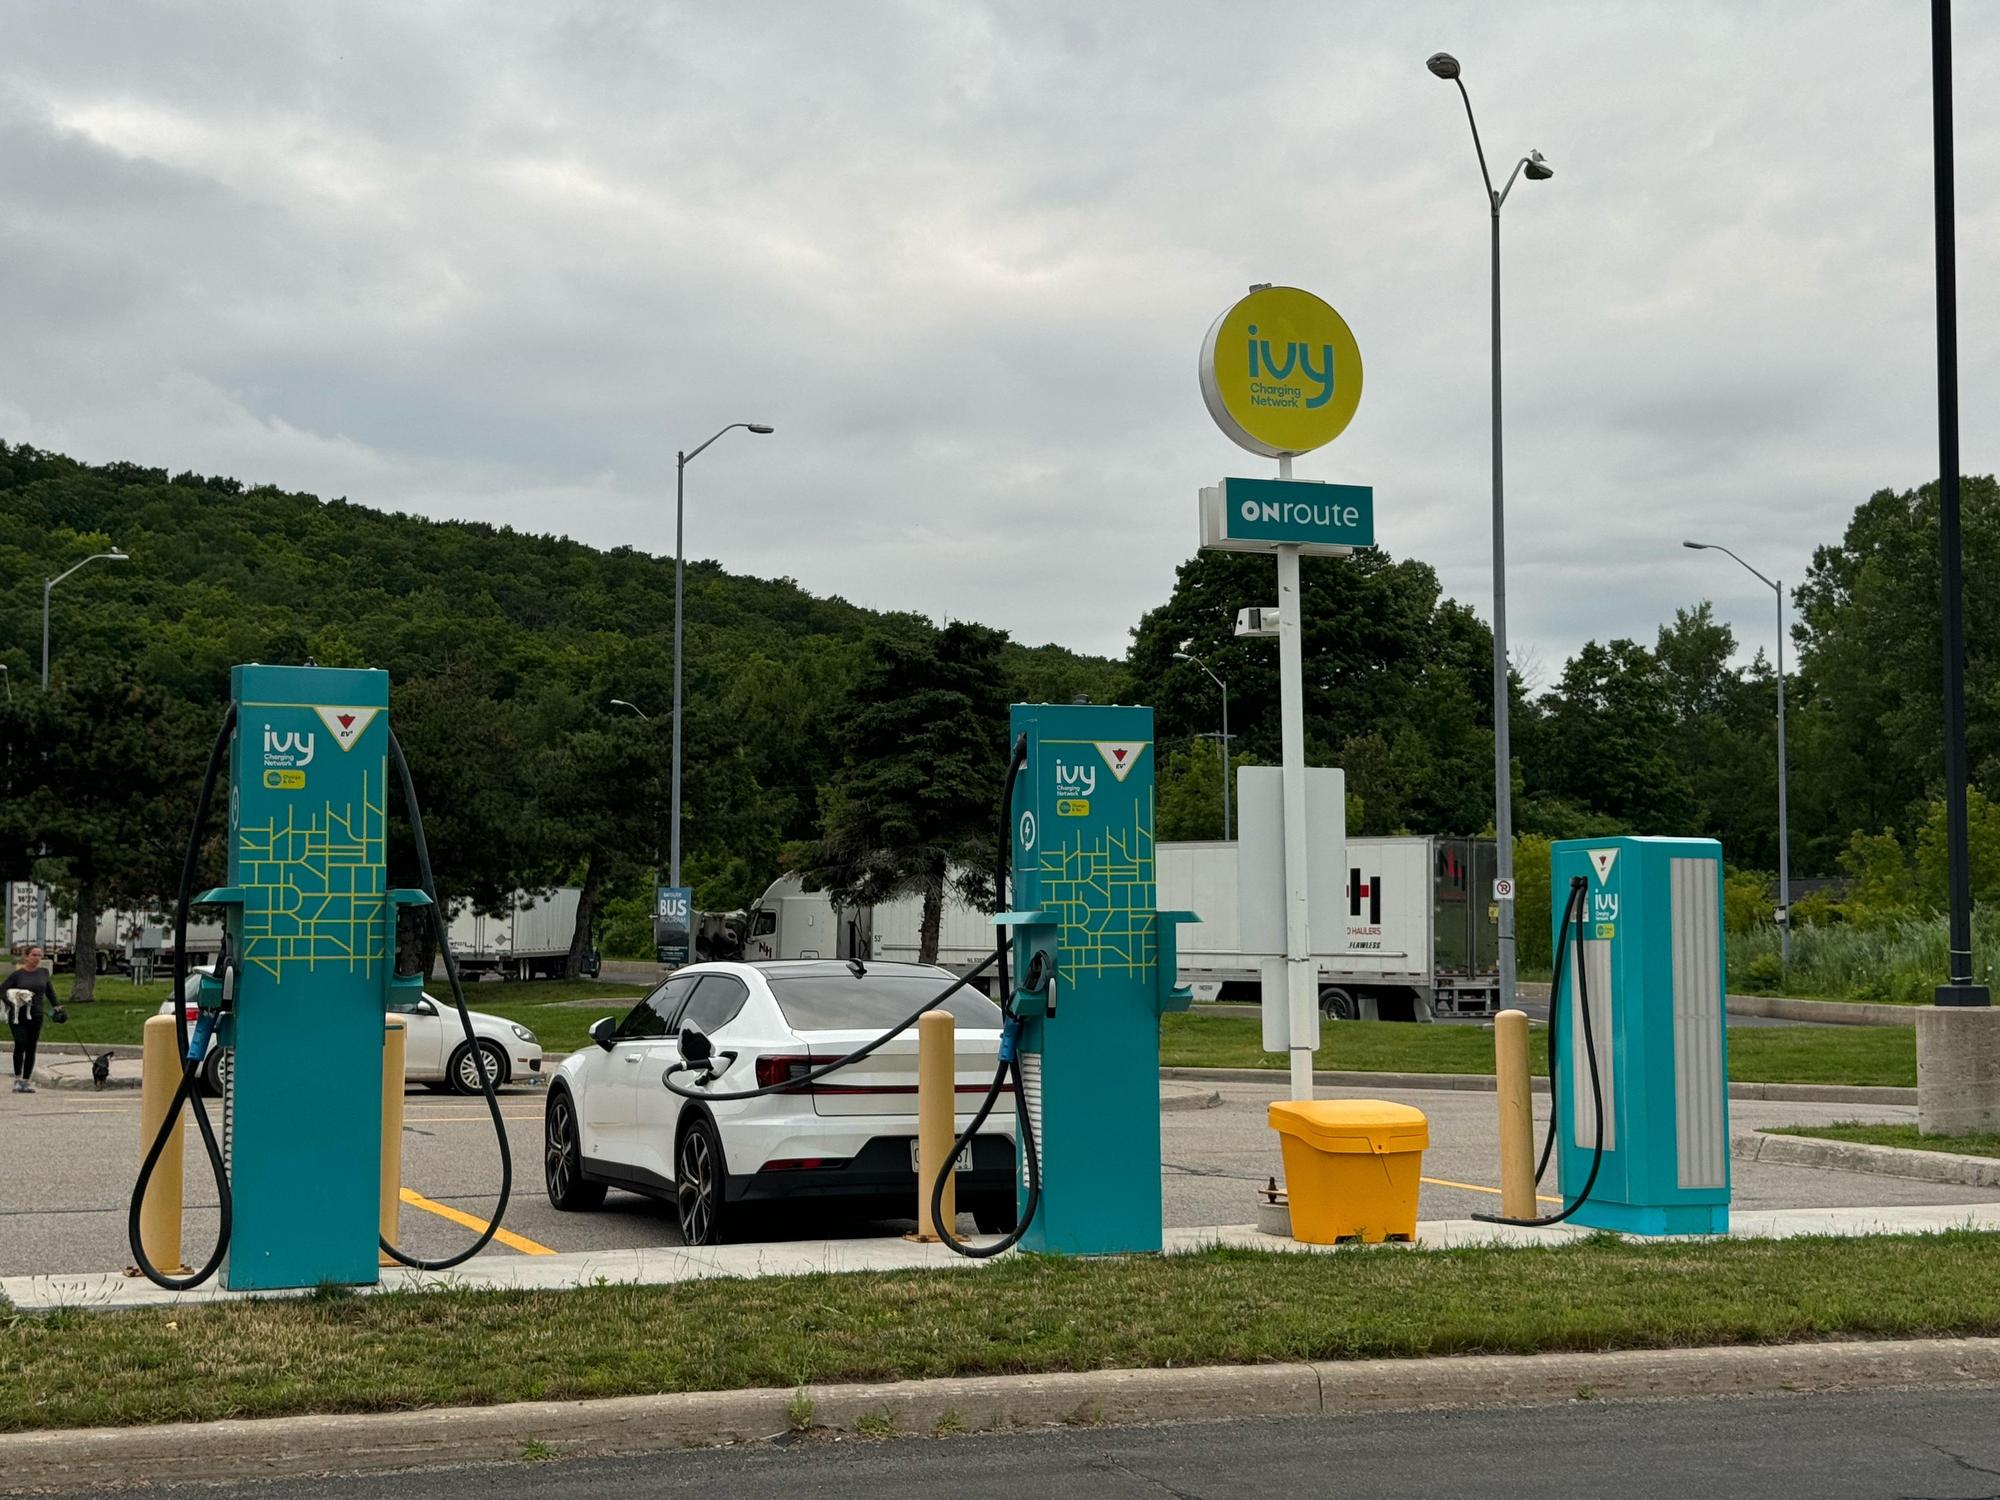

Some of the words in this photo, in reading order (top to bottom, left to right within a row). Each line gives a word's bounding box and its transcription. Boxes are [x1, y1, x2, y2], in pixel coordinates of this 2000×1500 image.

[1248, 324, 1335, 409] ivy
[1250, 382, 1301, 399] Charging
[1251, 395, 1299, 408] Network
[1241, 499, 1359, 527] ONroute
[264, 723, 314, 767] ivy
[264, 753, 294, 762] Charging
[1056, 758, 1095, 796] ivy
[1056, 785, 1080, 794] Charging
[660, 899, 687, 917] BUS
[1595, 888, 1619, 920] ivy
[1352, 927, 1381, 935] HAULERS
